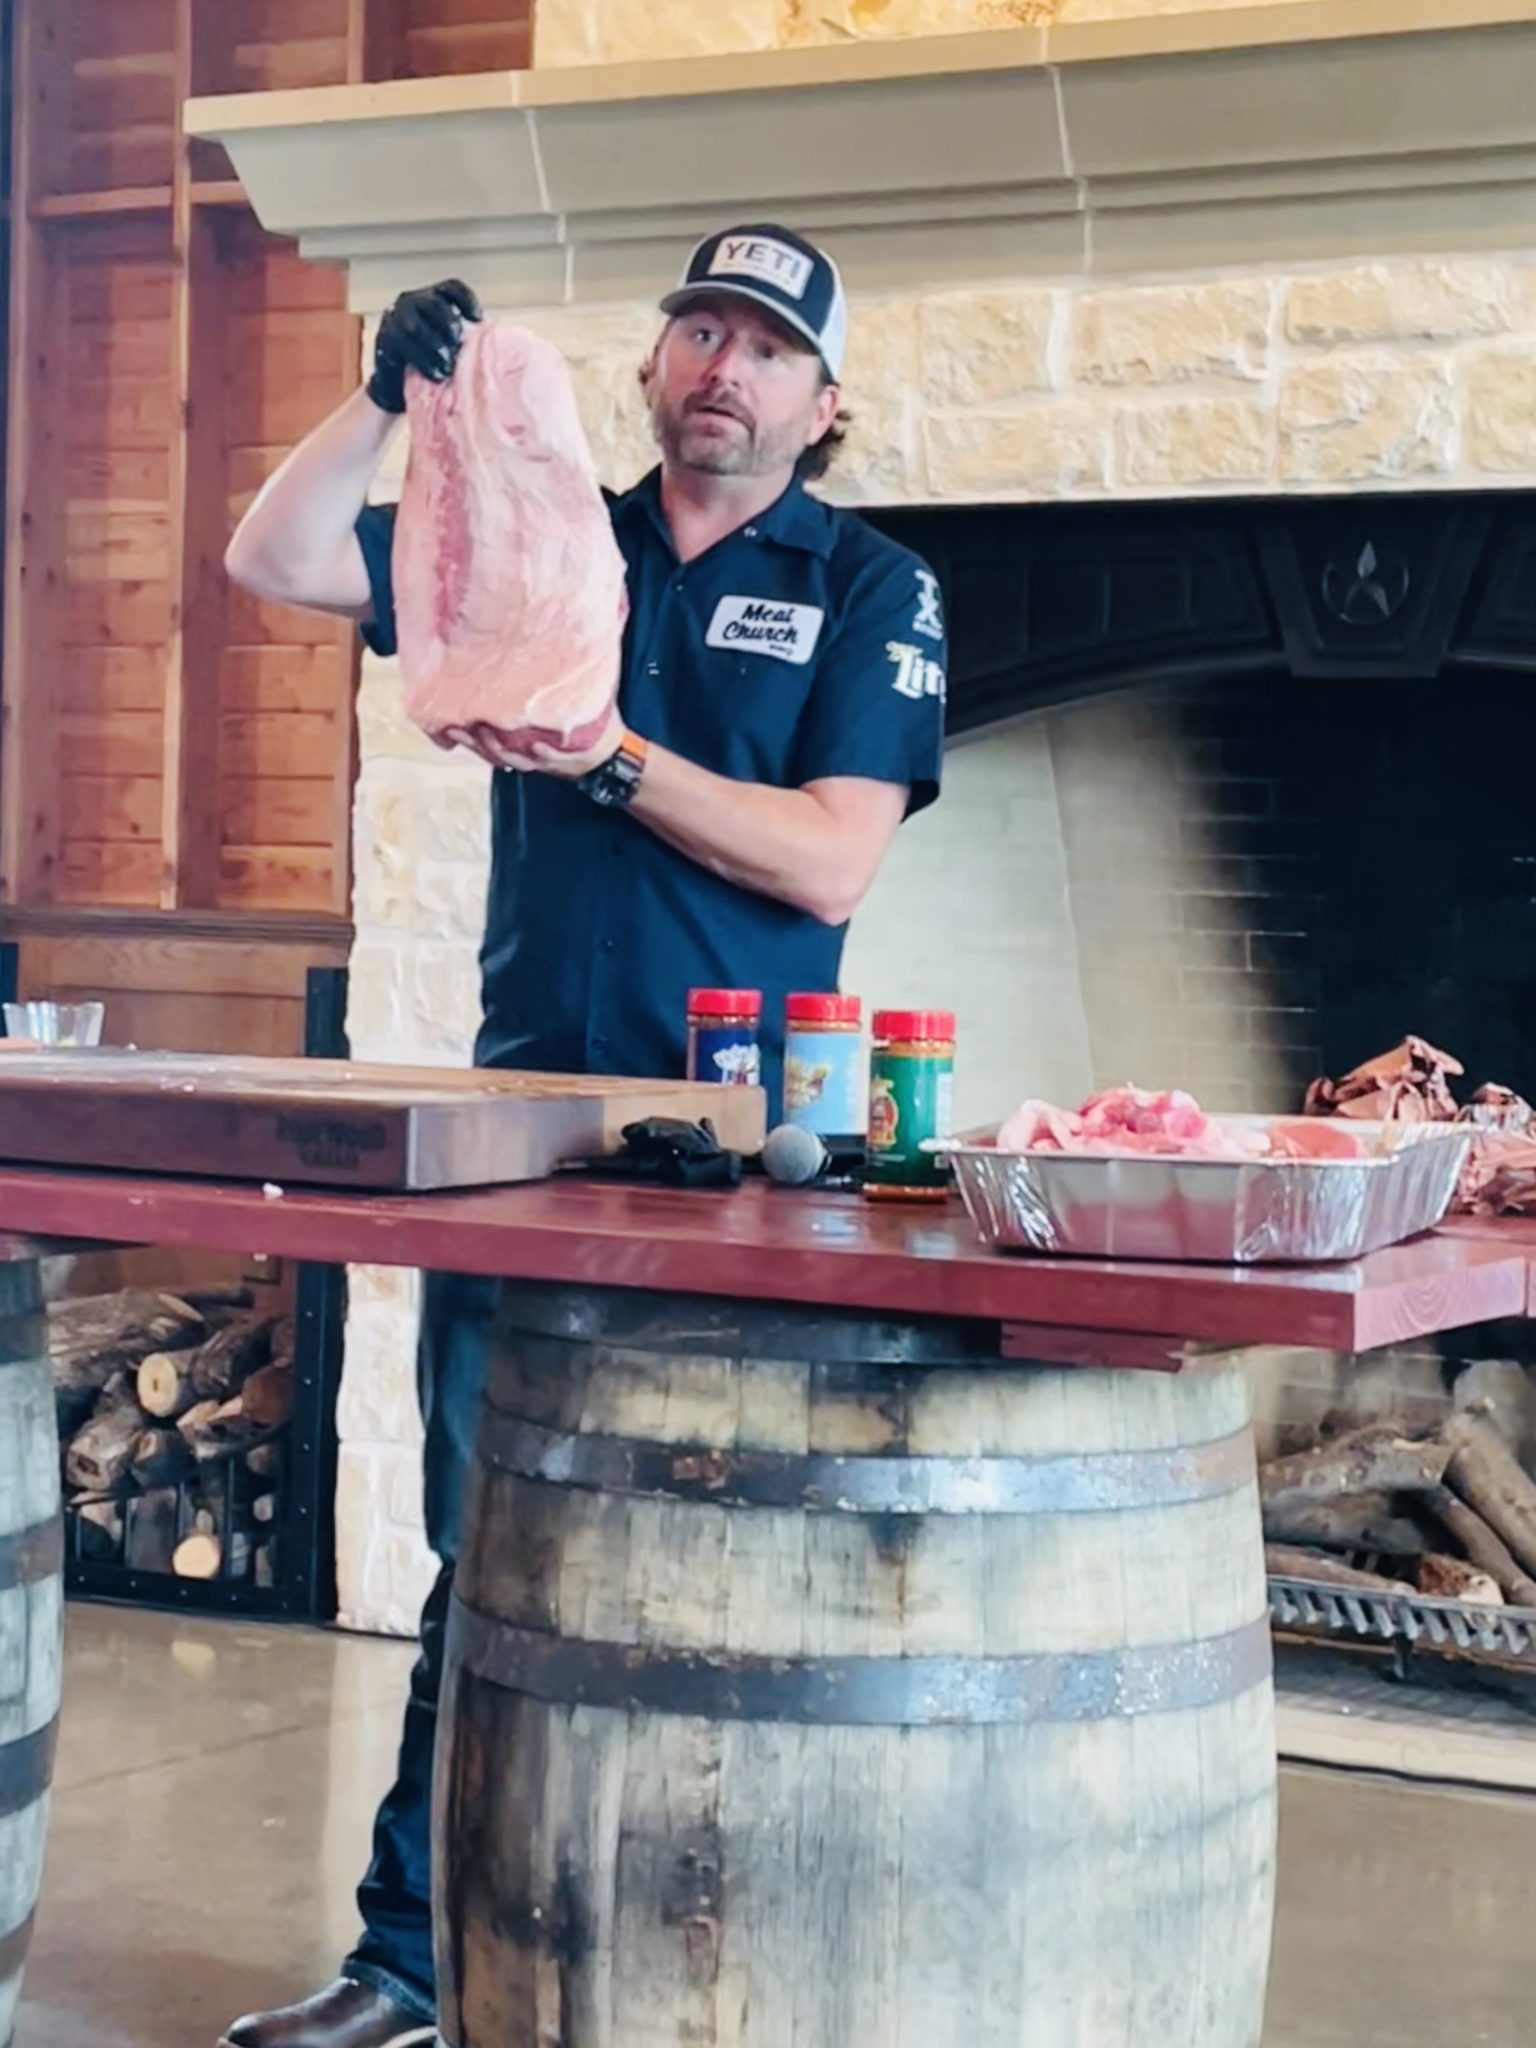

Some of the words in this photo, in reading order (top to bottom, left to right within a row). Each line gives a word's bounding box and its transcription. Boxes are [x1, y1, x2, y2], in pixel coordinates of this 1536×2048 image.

[726, 241, 802, 280] YETI
[741, 603, 795, 623] Meat
[722, 621, 798, 645] Church
